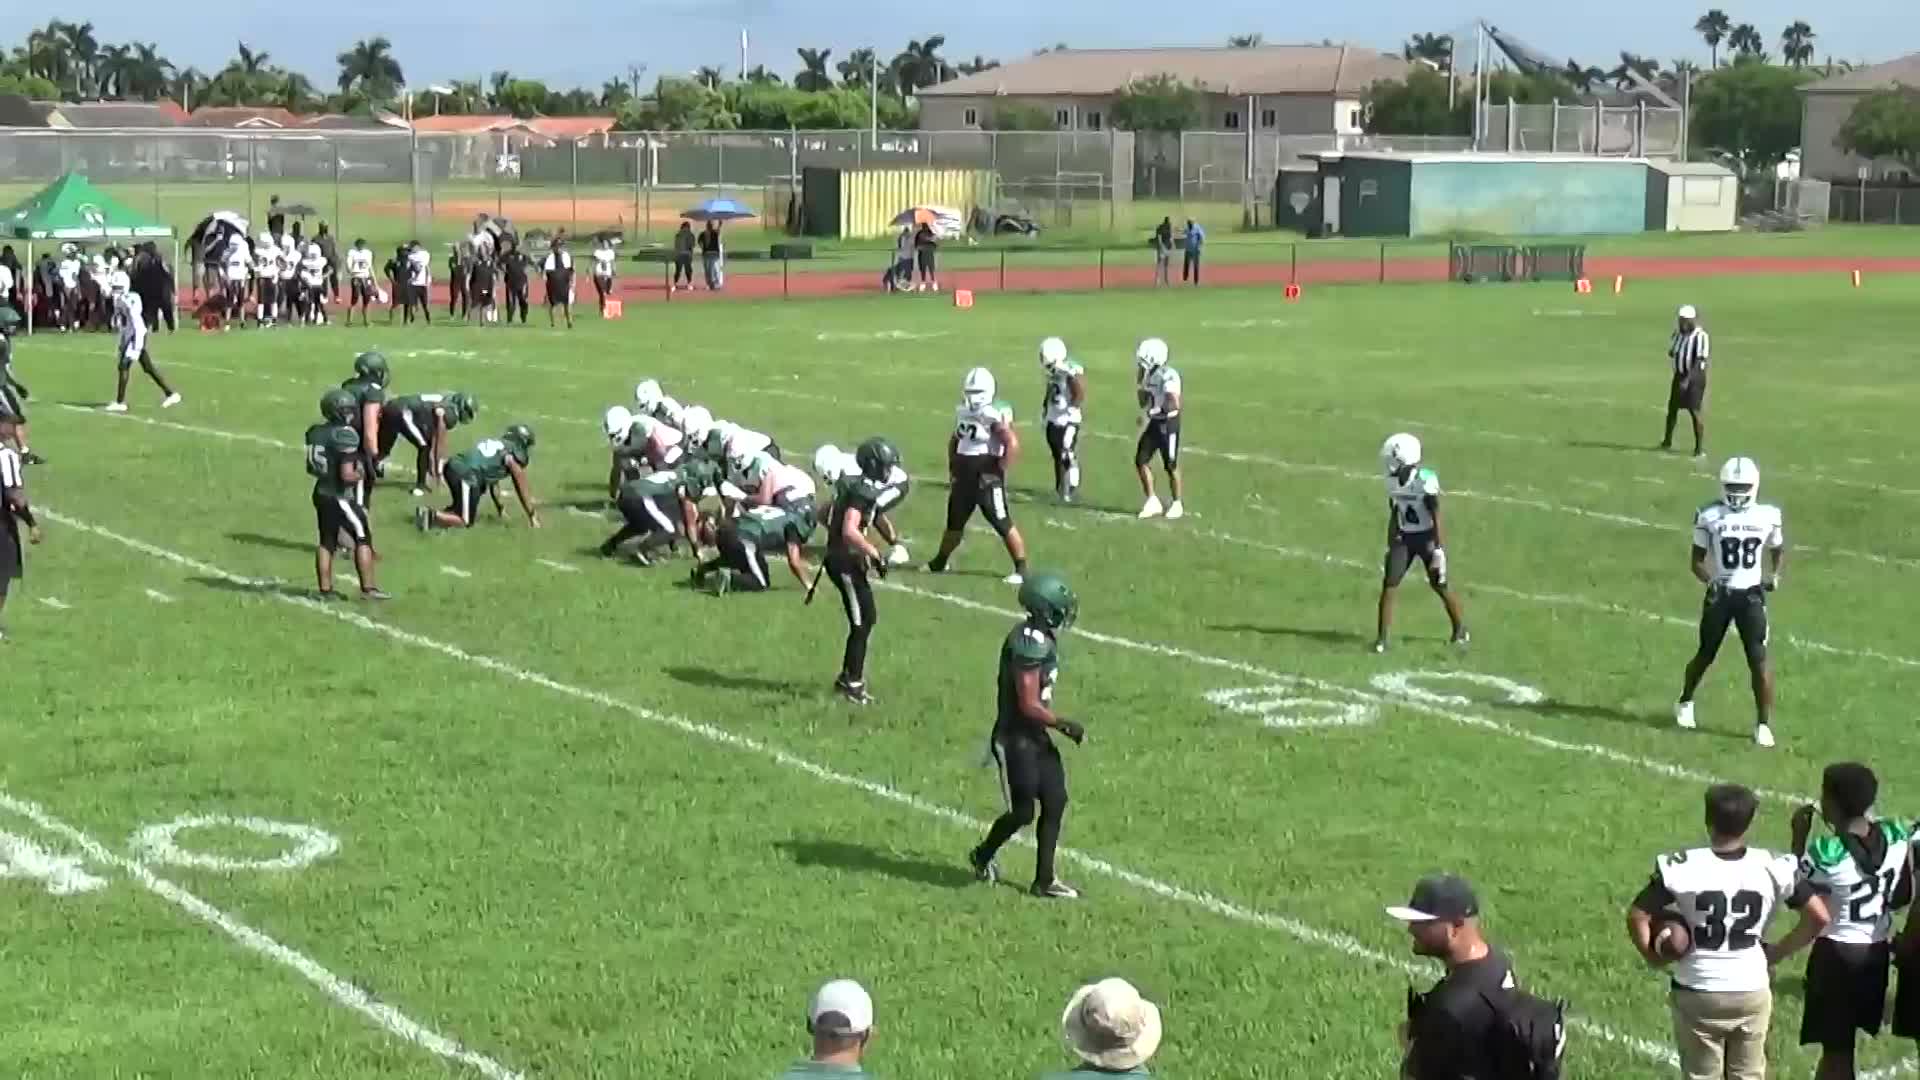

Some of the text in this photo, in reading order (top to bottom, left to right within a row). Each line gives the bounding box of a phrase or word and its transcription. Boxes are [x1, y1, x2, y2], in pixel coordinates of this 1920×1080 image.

[1720, 537, 1762, 570] 88
[1694, 889, 1764, 951] 32
[1849, 867, 1896, 922] 21
